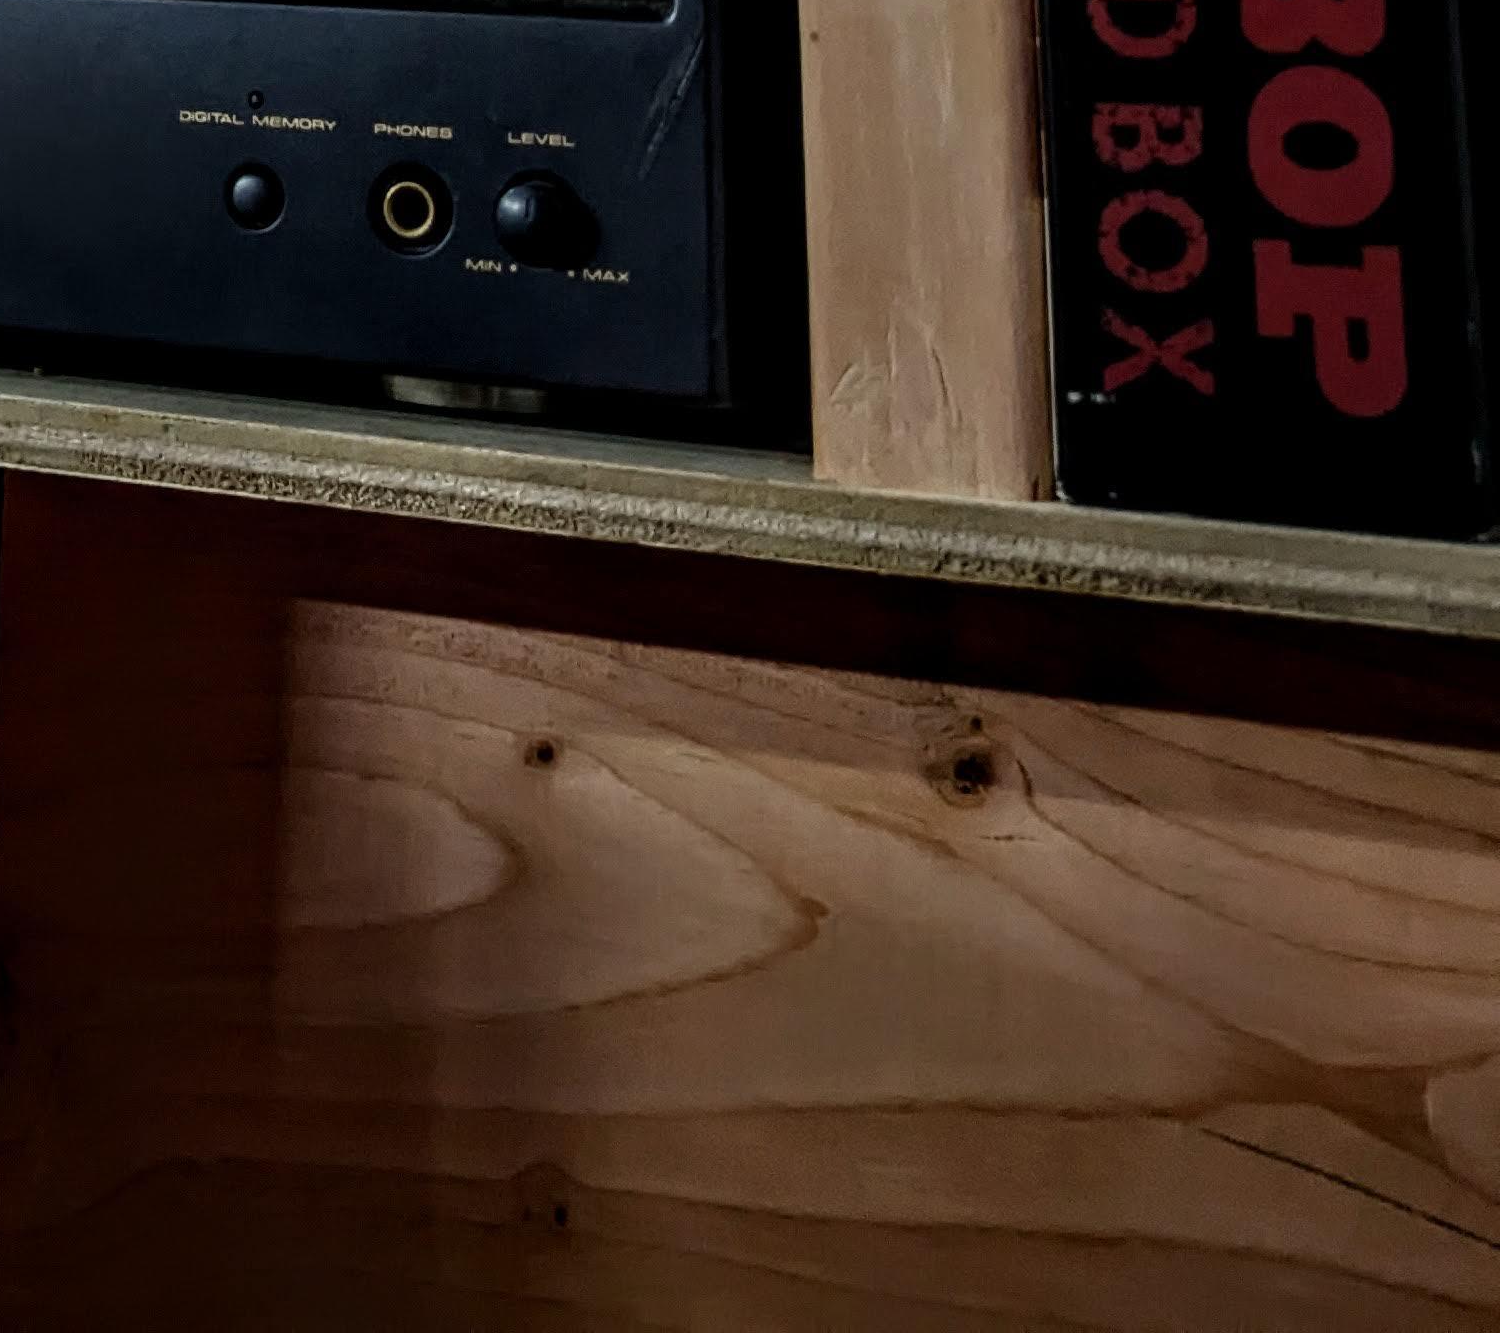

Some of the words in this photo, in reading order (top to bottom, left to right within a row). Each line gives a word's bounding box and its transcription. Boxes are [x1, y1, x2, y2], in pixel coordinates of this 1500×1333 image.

[179, 109, 245, 126] DIGITAL
[252, 114, 337, 132] MEMORY
[374, 122, 453, 140] PHONES
[507, 132, 576, 148] LEVEL
[1090, 101, 1216, 396] BOX
[465, 258, 503, 272] MIN
[582, 268, 630, 283] MAX
